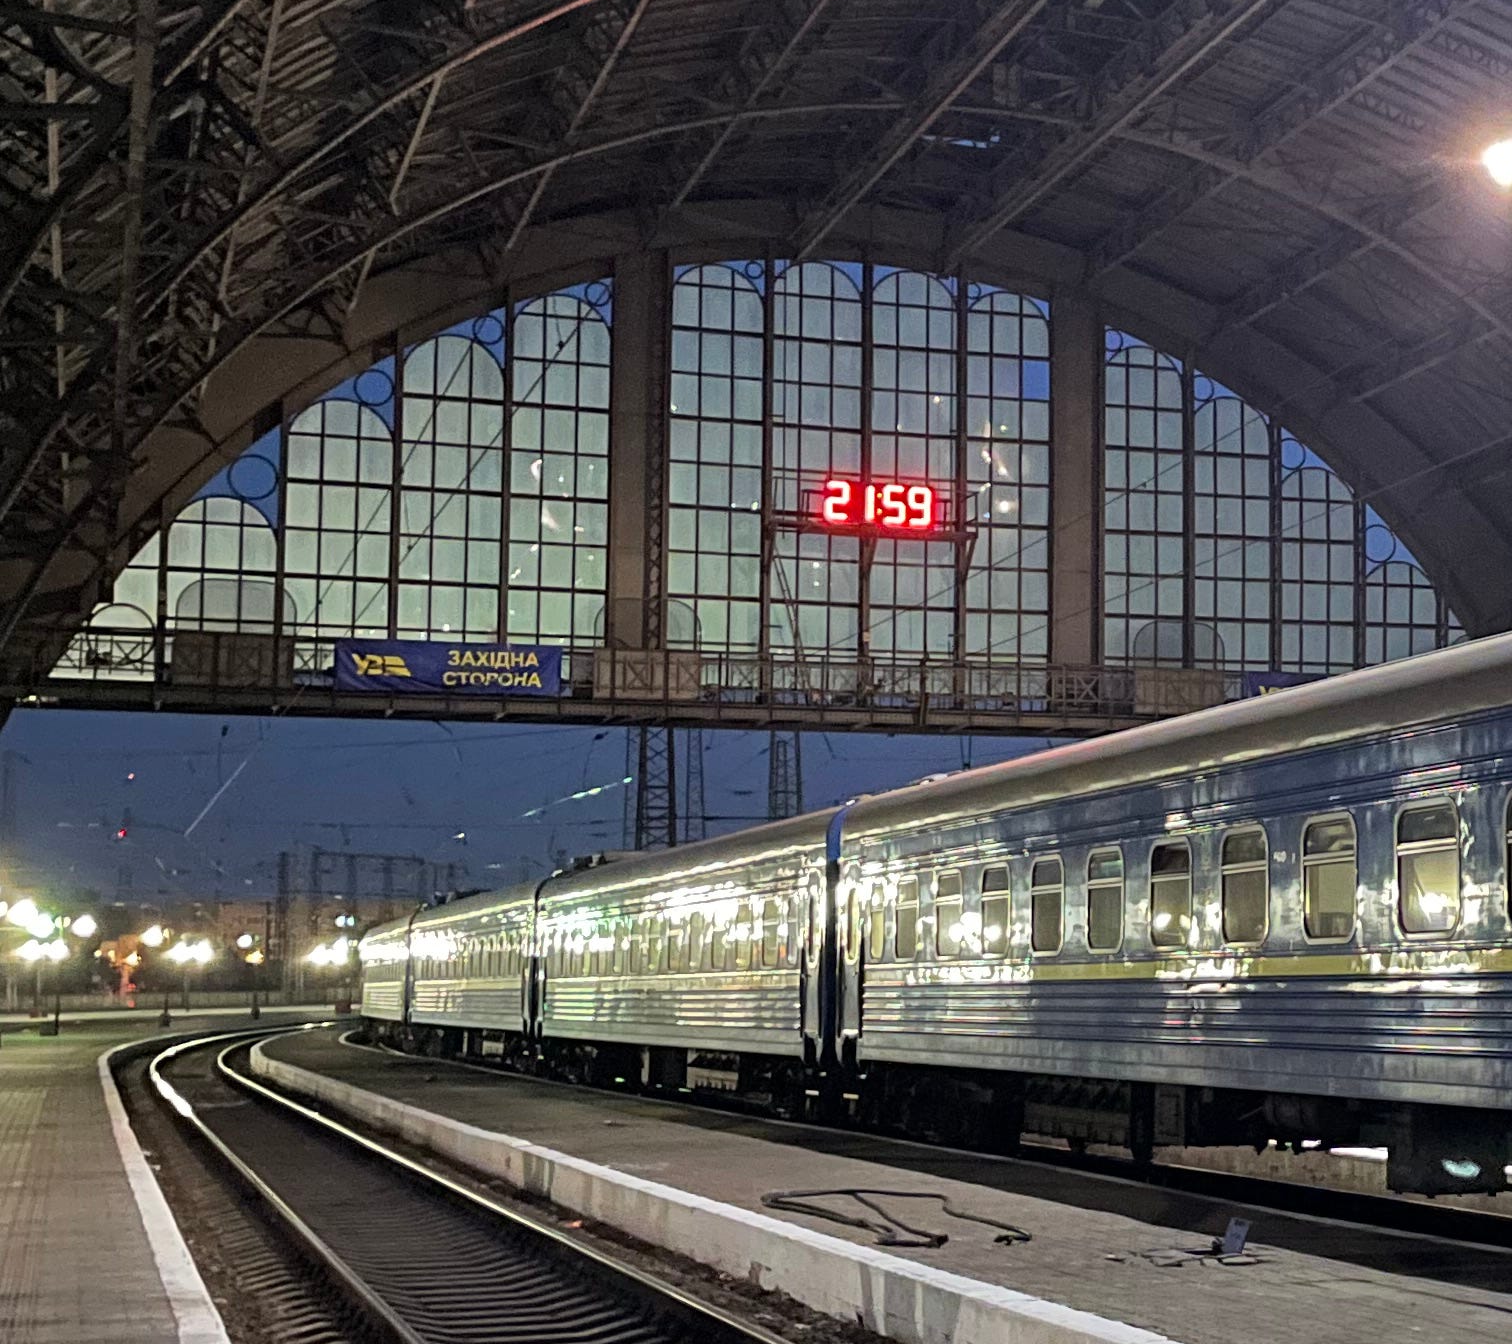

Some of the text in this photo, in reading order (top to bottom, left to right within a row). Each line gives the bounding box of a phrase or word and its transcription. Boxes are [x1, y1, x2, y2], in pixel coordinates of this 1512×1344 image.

[823, 480, 932, 526] 21:59
[447, 650, 539, 669] ЗАХІДНА
[442, 670, 542, 688] СТОРОНА
